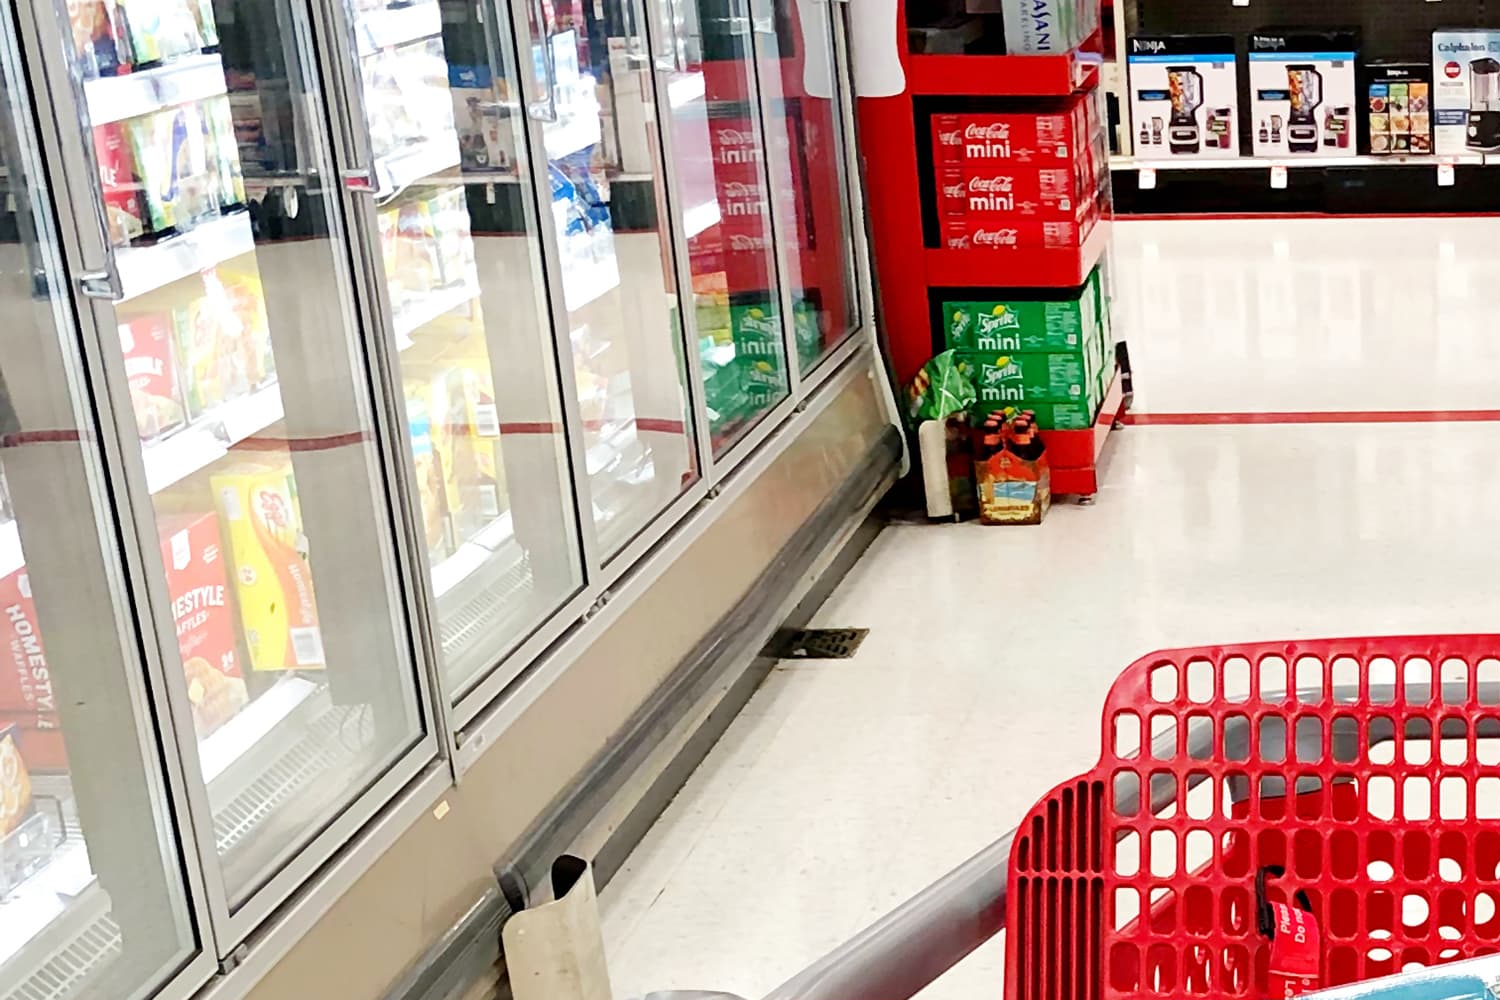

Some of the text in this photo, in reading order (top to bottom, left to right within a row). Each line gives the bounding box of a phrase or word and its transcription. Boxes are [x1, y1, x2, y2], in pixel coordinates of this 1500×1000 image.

[1133, 39, 1166, 53] NINJA
[1438, 42, 1486, 53] Calphalon
[965, 123, 1010, 139] Coca-Cola
[966, 140, 1010, 158] mini
[969, 176, 1014, 192] Coca-Cola
[970, 193, 1014, 211] mini
[973, 229, 1018, 245] Coca-Cola
[981, 313, 1015, 333] Sprite
[978, 333, 1020, 350] mini
[982, 384, 1024, 400] mini
[1295, 926, 1306, 943] Do
